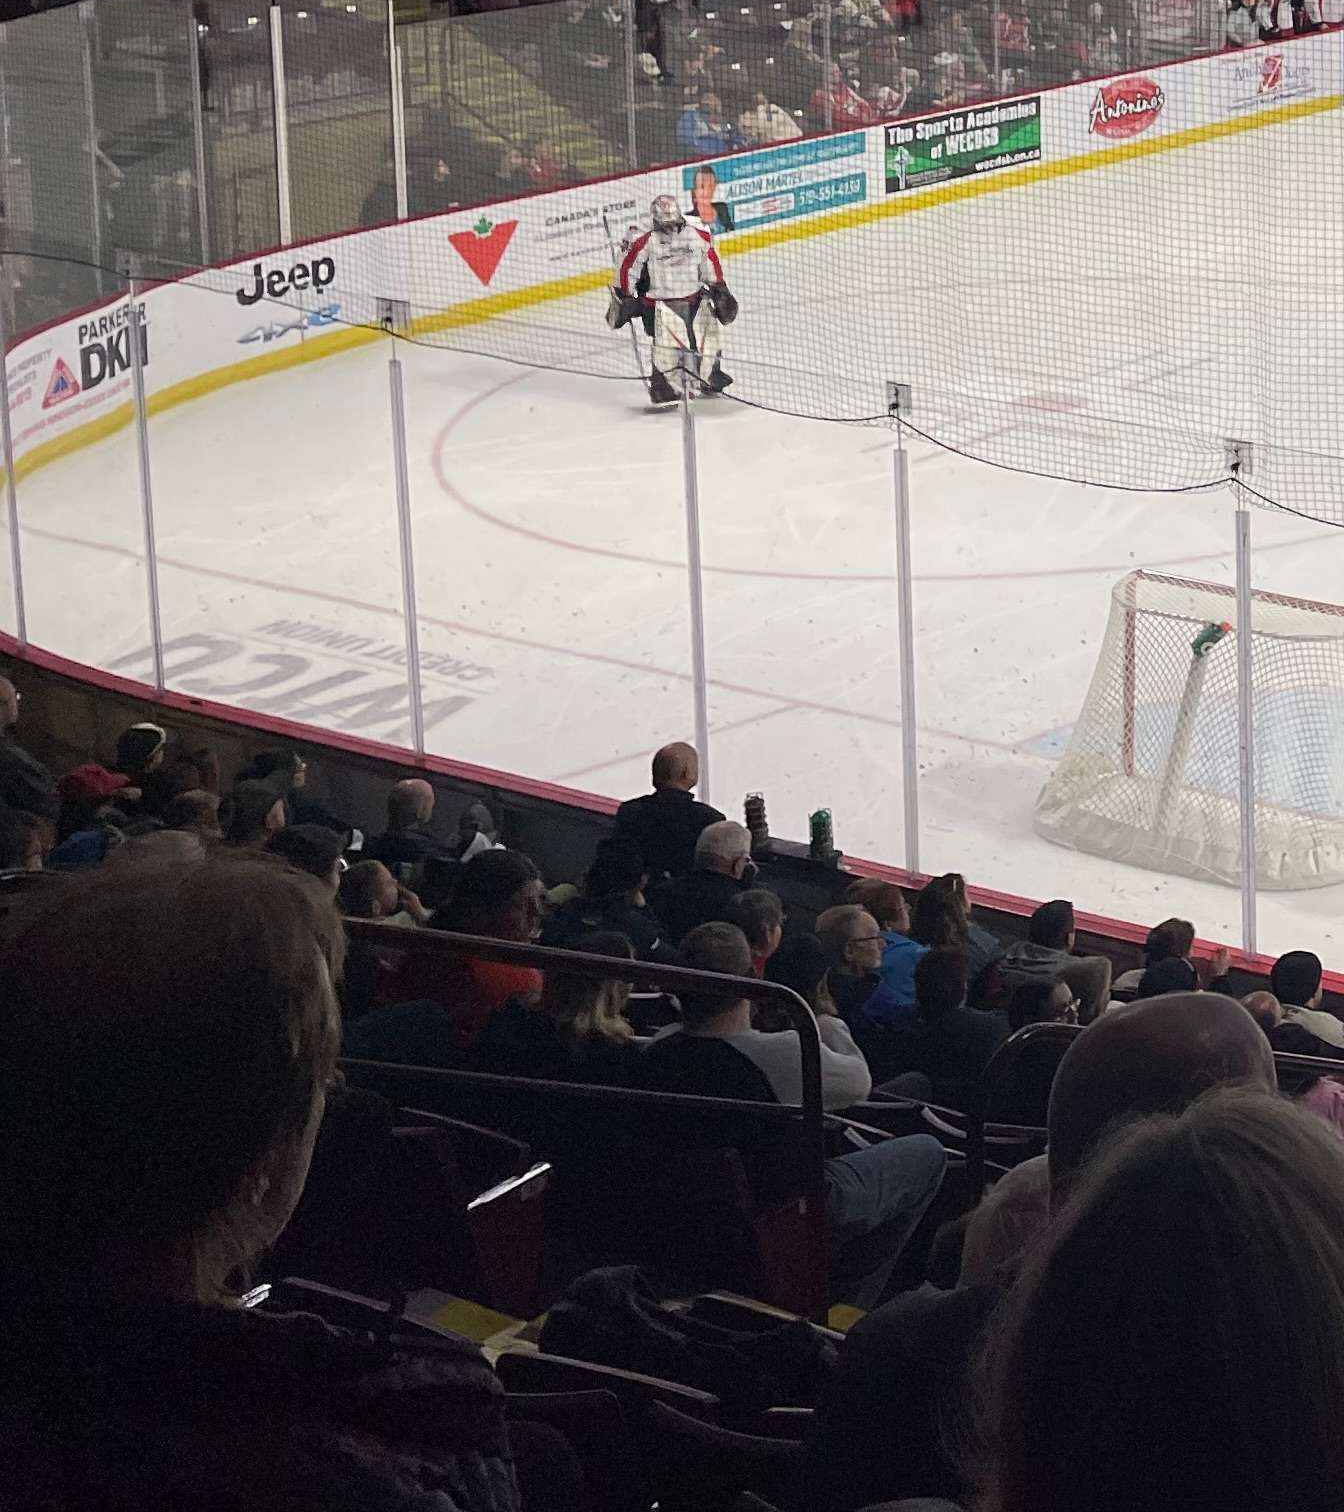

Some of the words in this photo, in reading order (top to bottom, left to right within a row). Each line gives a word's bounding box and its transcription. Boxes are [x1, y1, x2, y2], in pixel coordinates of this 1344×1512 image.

[888, 126, 913, 145] The
[916, 114, 964, 141] Sports
[967, 100, 1037, 129] Academies
[1088, 86, 1167, 135] Antonino's
[930, 144, 943, 160] of
[236, 256, 336, 306] Jeep
